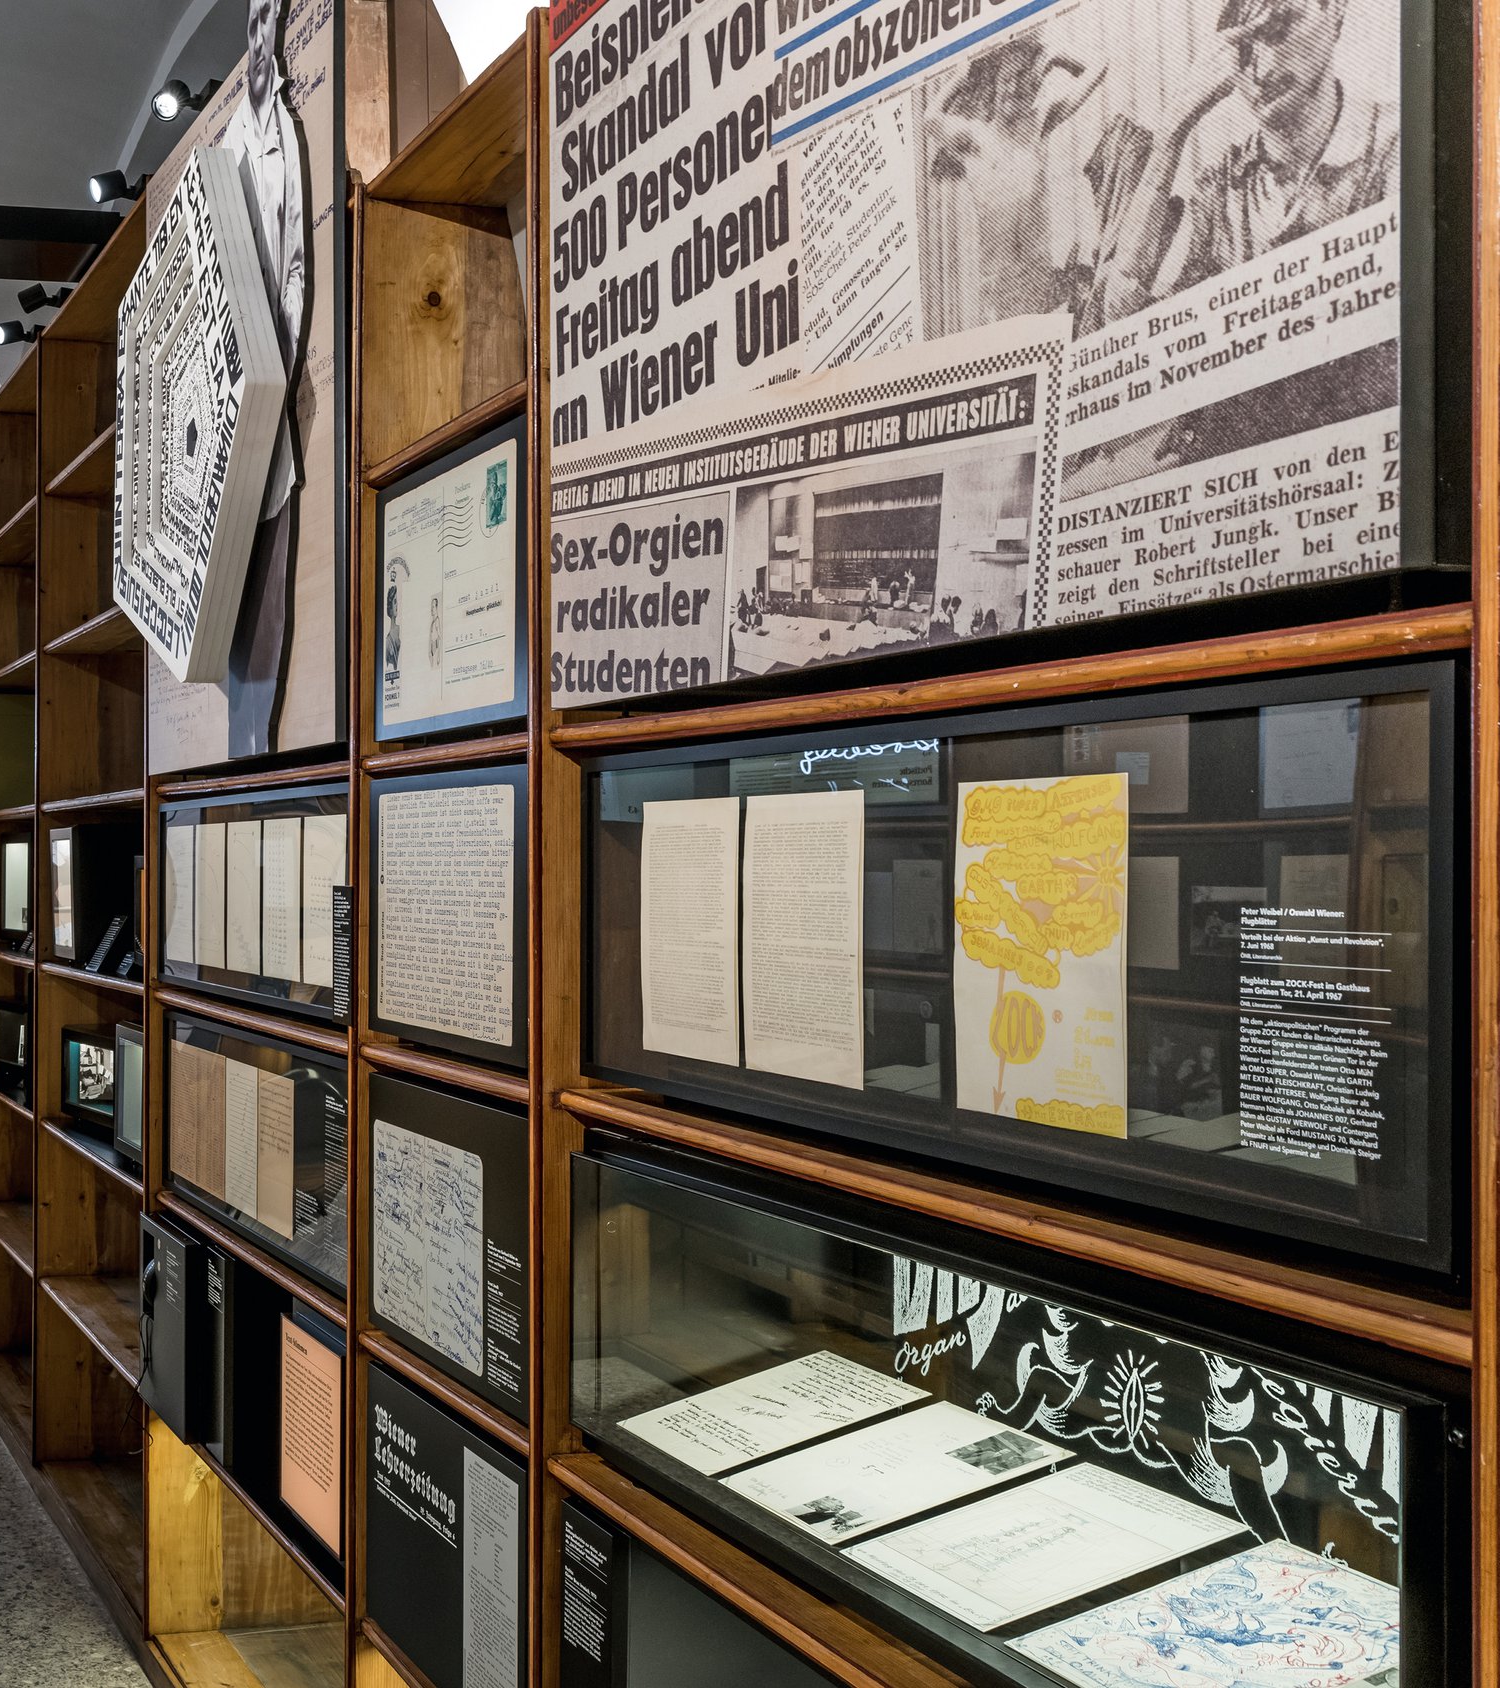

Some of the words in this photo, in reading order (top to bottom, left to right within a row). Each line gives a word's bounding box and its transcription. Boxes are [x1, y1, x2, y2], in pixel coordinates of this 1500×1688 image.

[772, 47, 830, 120] dem
[561, 33, 691, 202] Skandal
[817, 176, 832, 196] den
[837, 159, 858, 188] nicht
[849, 145, 882, 190] darüber
[554, 195, 606, 293] 500
[557, 260, 659, 377] Freitag
[672, 159, 789, 307] abend
[836, 289, 858, 317] dann
[894, 233, 908, 252] sie
[1147, 305, 1199, 339] Brus,
[1208, 276, 1263, 312] einer
[1273, 255, 1310, 285] der
[1321, 210, 1400, 263] Haupt
[1164, 330, 1207, 359] vom
[1221, 252, 1383, 336] Freitagabend,
[552, 388, 588, 447] an
[600, 320, 717, 431] Wiener
[735, 259, 799, 368] Uni
[1126, 376, 1153, 402] im
[1159, 330, 1269, 390] November
[1277, 312, 1316, 343] des
[1326, 281, 1400, 324] Jahre
[552, 489, 589, 511] FREITAG
[591, 481, 626, 505] ABEND
[628, 475, 641, 497] IM
[644, 467, 680, 495] NEUEN
[682, 433, 805, 487] INSTITUTSGEBÄUDE
[809, 428, 838, 462] DER
[843, 414, 901, 455] WIENER
[906, 388, 1027, 442] UNIVERSITÄT:
[1056, 485, 1193, 535] DISTANZIERT
[1204, 467, 1259, 499] SICH
[1273, 460, 1312, 481] von
[1326, 445, 1366, 468] den
[1056, 535, 1109, 559] zessen
[1121, 525, 1144, 545] im
[1160, 471, 1364, 535] Universitätshörsaal:
[550, 512, 724, 577] Sex-Orgien
[1056, 556, 1122, 582] schauer
[1134, 535, 1196, 567] Robert
[1211, 517, 1280, 550] Jungk.
[1295, 502, 1359, 530] Unser
[1057, 581, 1097, 605] zeigt
[1108, 576, 1140, 596] den
[1152, 547, 1281, 587] Schriftsteller
[1302, 535, 1334, 557] bei
[557, 581, 710, 633] radikaler
[1208, 578, 1236, 600] als
[550, 647, 710, 694] Studenten
[1240, 907, 1259, 916] Peter
[1260, 907, 1283, 916] Weibel
[1288, 908, 1316, 917] Oswald
[1316, 909, 1345, 918] Wiener:
[1240, 917, 1278, 927] Flugblätter
[1240, 933, 1262, 941] Verteilt
[1262, 933, 1273, 941] bei
[1273, 934, 1284, 942] der
[1285, 935, 1306, 943] Aktion
[1329, 937, 1343, 945] und
[1240, 976, 1269, 986] Flugblatt
[1270, 979, 1285, 987] zum
[1285, 979, 1325, 990] ZOCK-Fest
[1325, 982, 1335, 990] im
[1335, 983, 1371, 993] Gasthaus
[1254, 987, 1280, 996] Grünen
[1306, 990, 1324, 1001] April
[1261, 1028, 1280, 1037] ZOCK
[895, 1332, 967, 1376] Organ
[374, 1404, 416, 1457] Wiener
